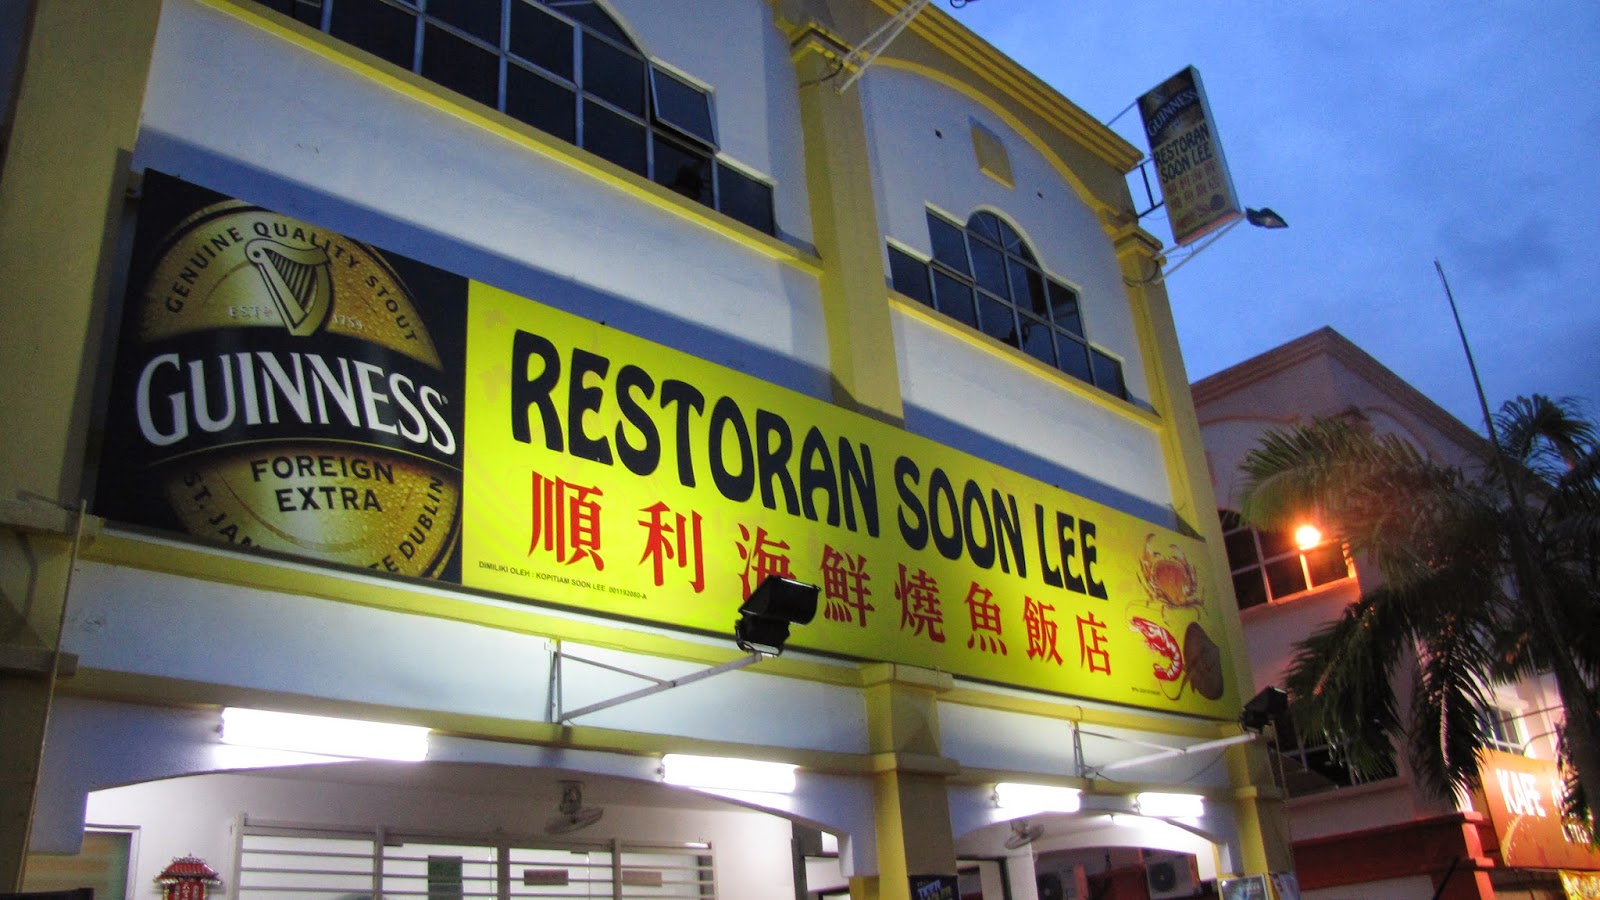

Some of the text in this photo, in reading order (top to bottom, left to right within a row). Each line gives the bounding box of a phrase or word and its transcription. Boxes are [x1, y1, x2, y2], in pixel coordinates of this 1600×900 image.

[1155, 122, 1210, 166] RESTORAN
[1161, 155, 1191, 184] SOON
[1191, 142, 1212, 166] LEE
[165, 221, 417, 343] GENUINE QUALITY STOUT
[136, 351, 456, 455] GUINNESS
[251, 455, 394, 484] FOREIGN
[511, 329, 1109, 600] RESTORAN SOON LEE
[275, 486, 383, 513] EXTRA
[400, 476, 444, 560] DUBLIN
[478, 560, 509, 573] DIMILIKI
[509, 567, 530, 577] OLEH
[535, 572, 570, 584] KOPITIAM
[571, 578, 591, 589] SOON
[592, 583, 606, 592] LEE
[1496, 769, 1546, 817] KAFE
